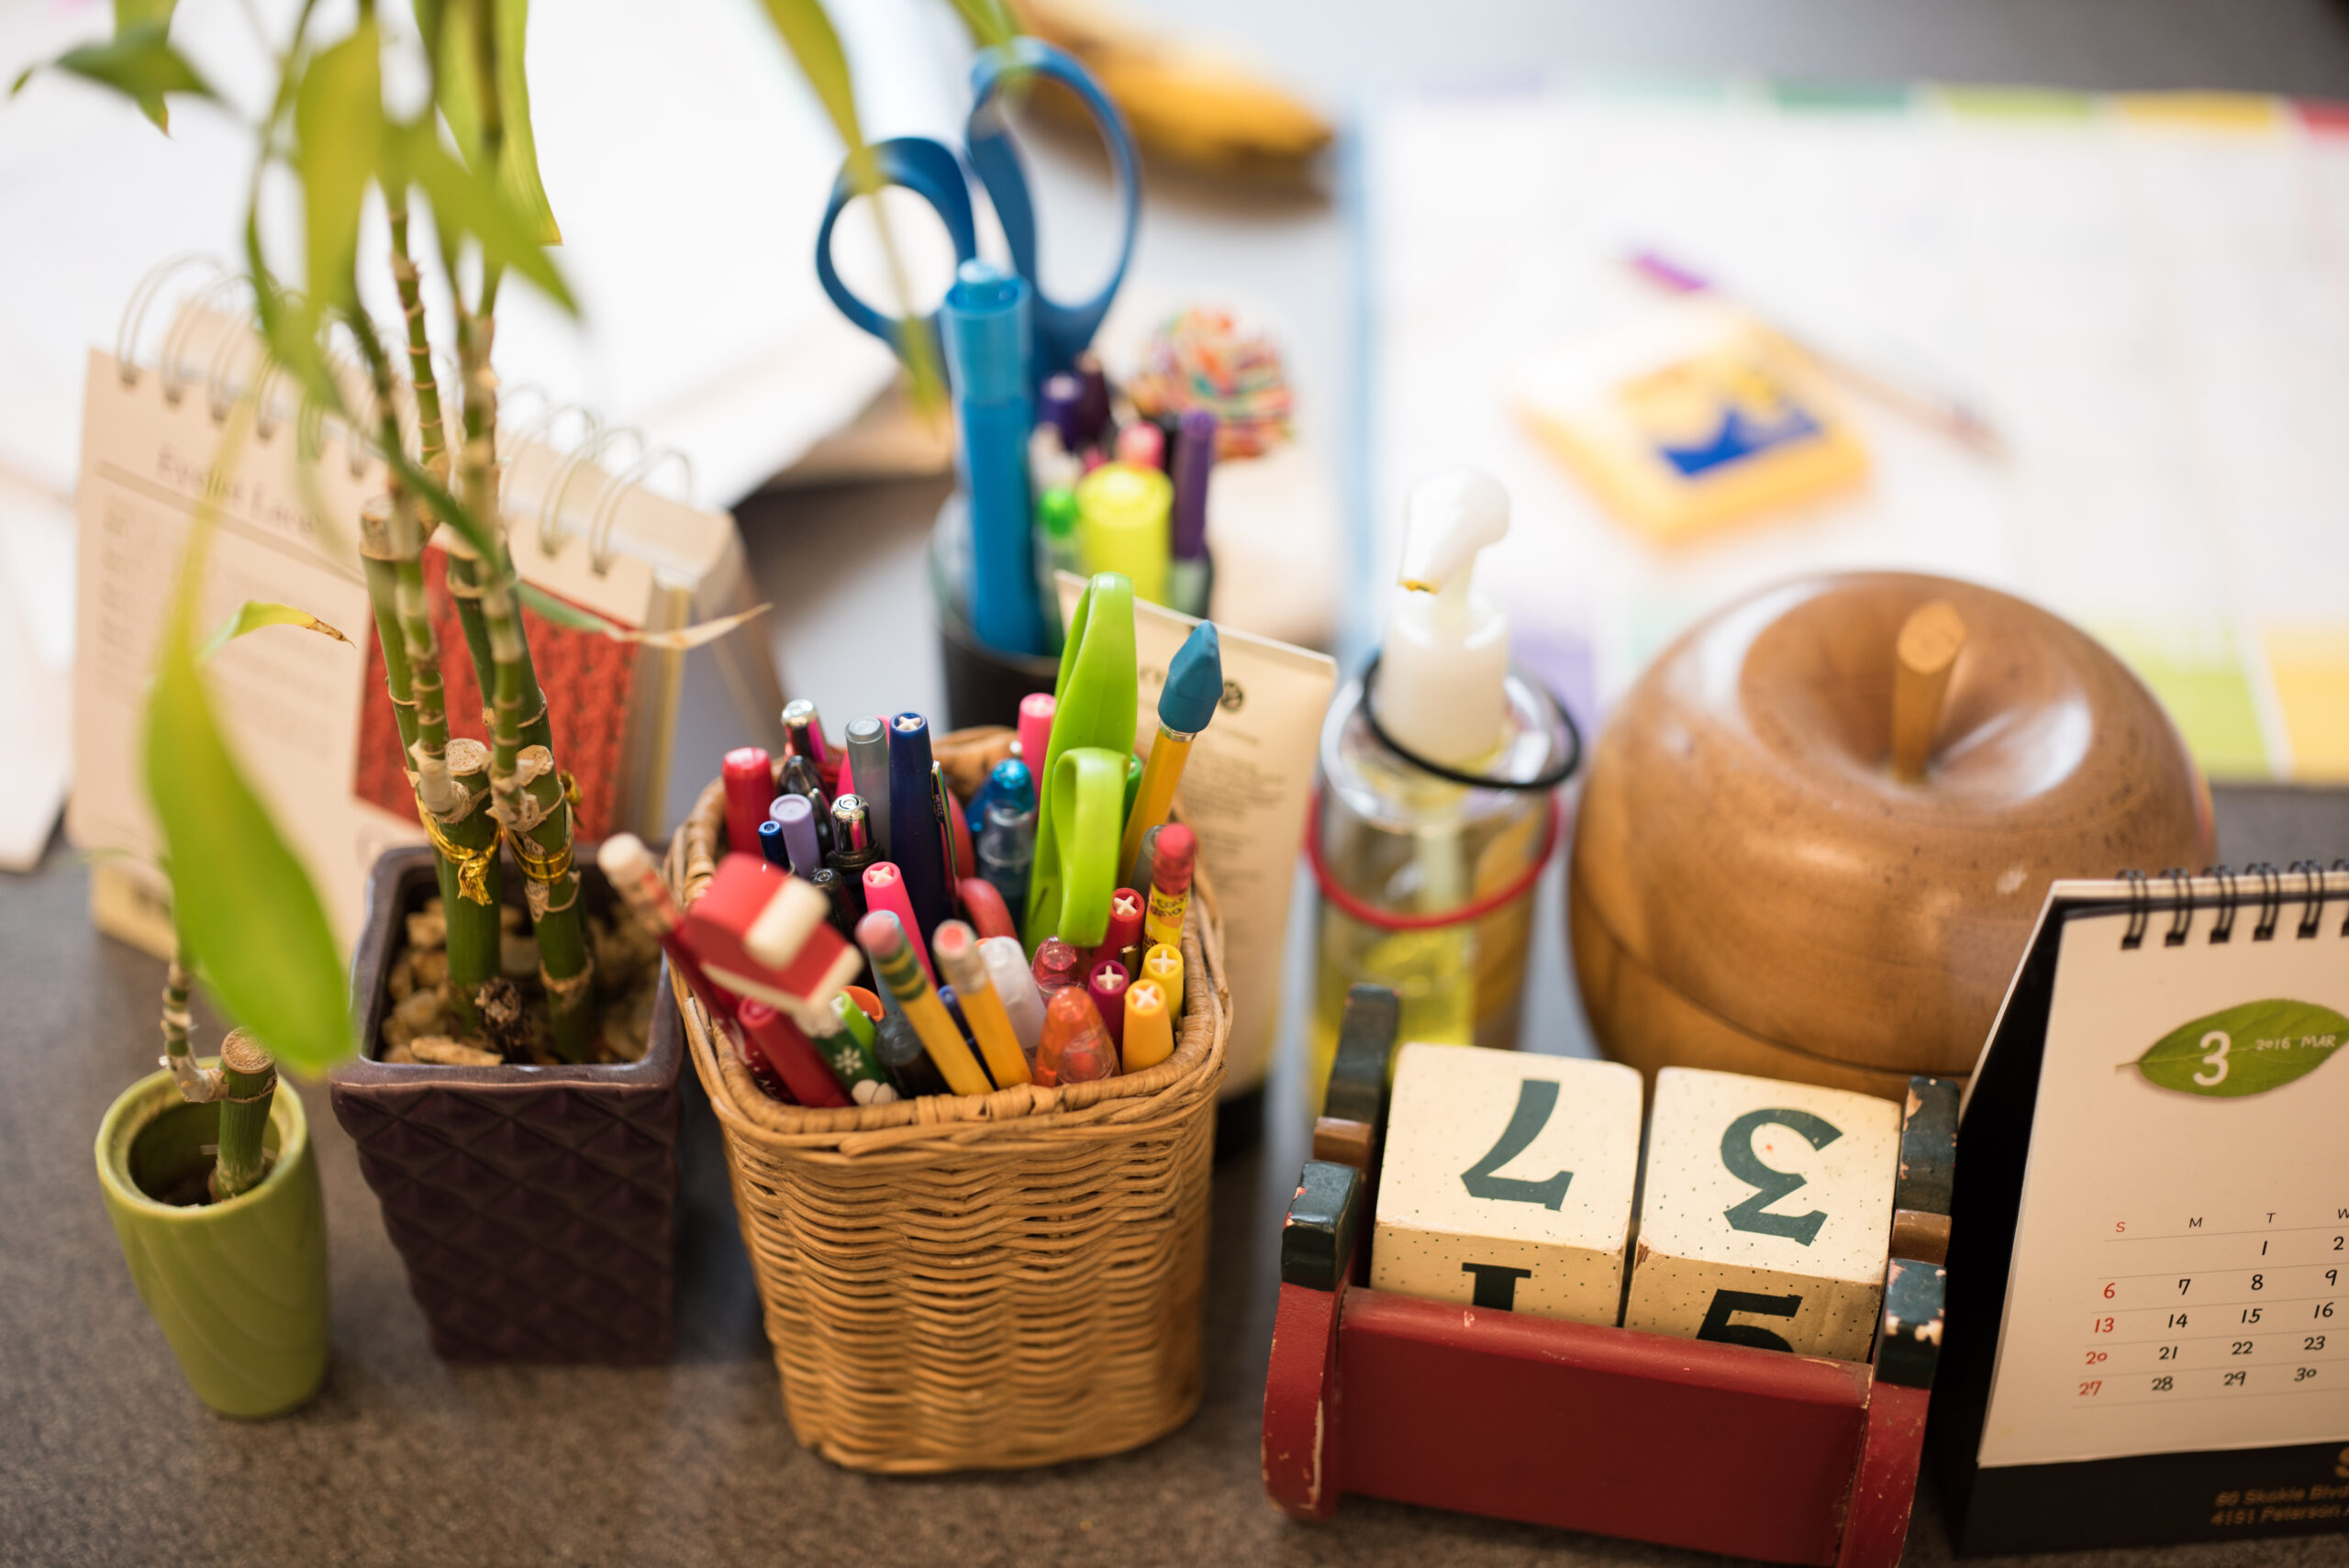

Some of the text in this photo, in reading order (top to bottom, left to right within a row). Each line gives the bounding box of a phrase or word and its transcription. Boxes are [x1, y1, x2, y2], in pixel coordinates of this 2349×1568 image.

[2192, 1030, 2337, 1086] 3 2016 MAR
[1461, 1078, 1575, 1211] 7
[1720, 1107, 1843, 1247] 3
[2115, 1207, 2349, 1233] S M T W
[2261, 1236, 2344, 1256] 1 2
[2103, 1269, 2338, 1299] 6 7 8 9
[2094, 1301, 2334, 1333] 13 14 15 16
[2085, 1335, 2326, 1365] 20 21 22 23
[2078, 1367, 2318, 1396] 27 28 29 30
[2259, 1505, 2342, 1523] Peterson
